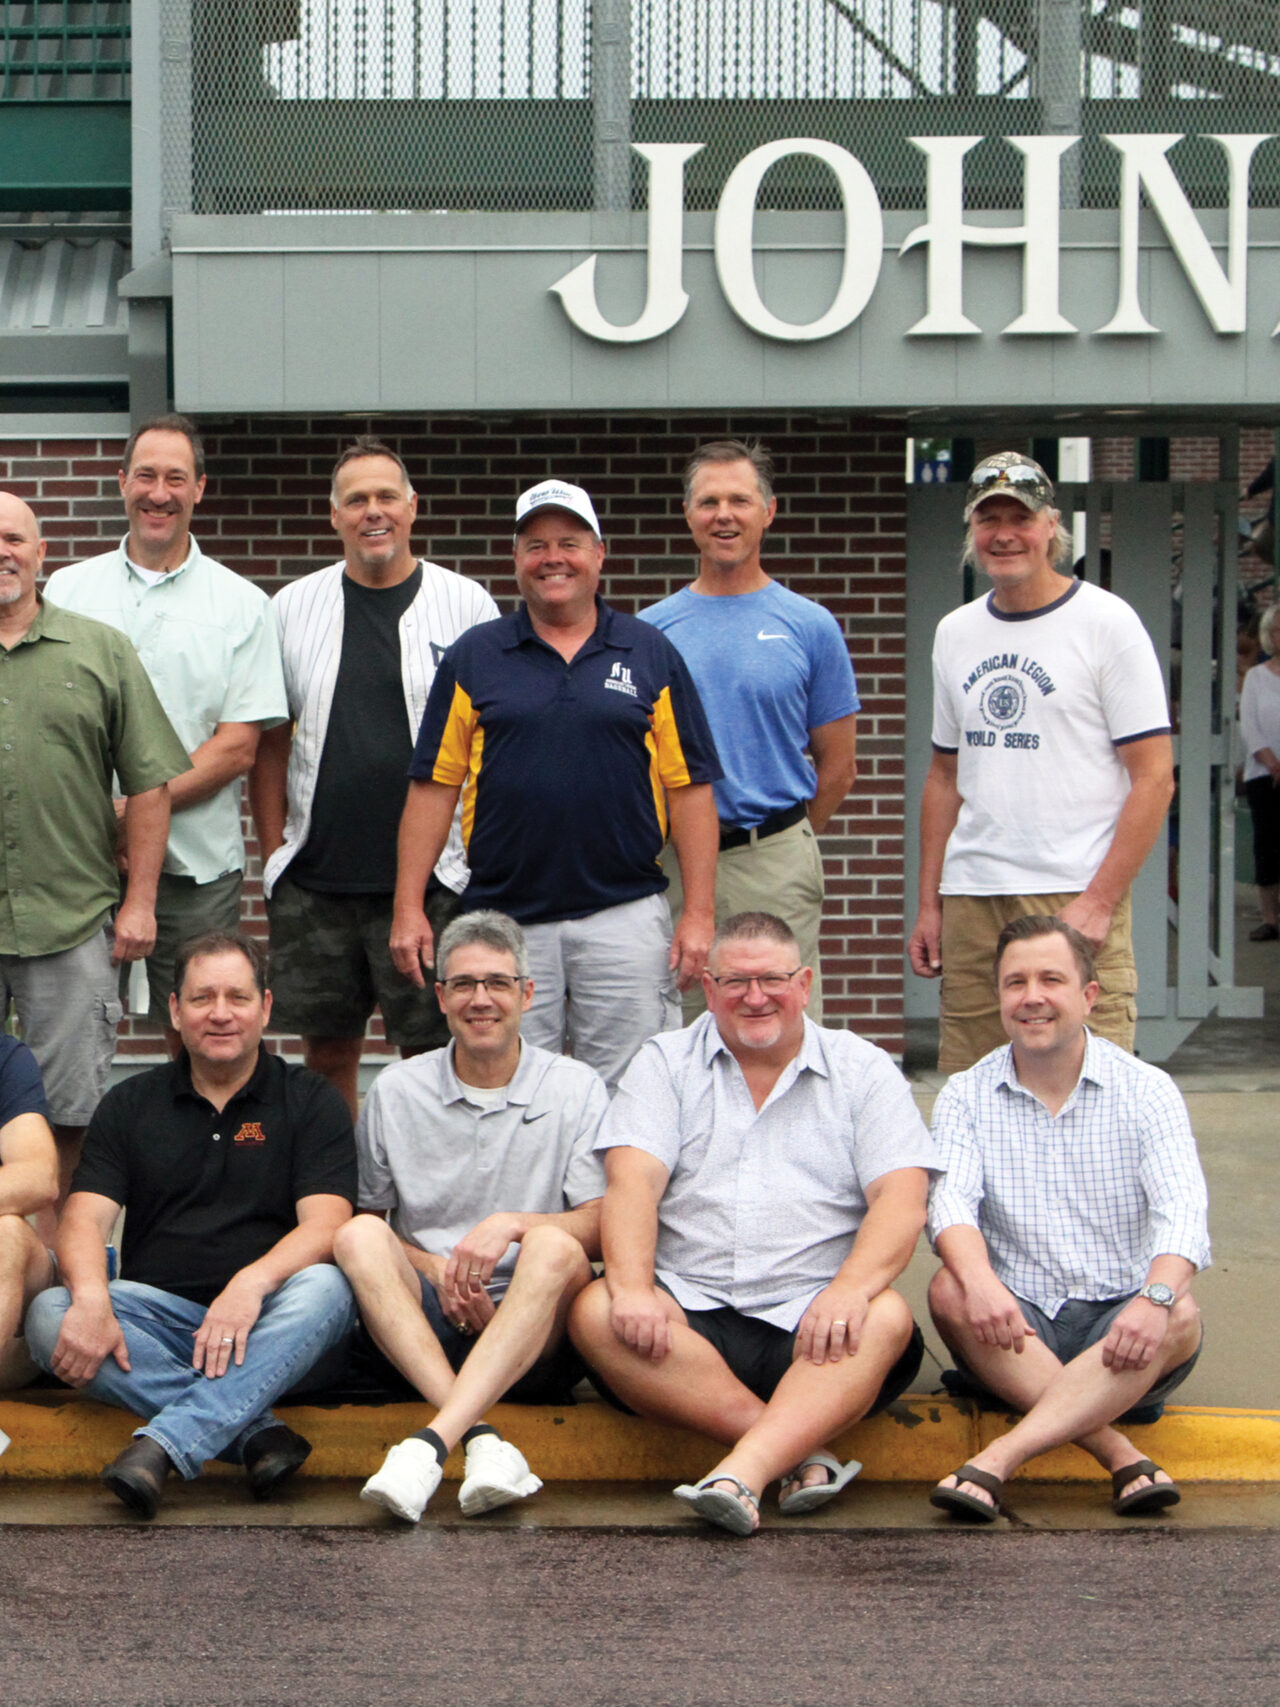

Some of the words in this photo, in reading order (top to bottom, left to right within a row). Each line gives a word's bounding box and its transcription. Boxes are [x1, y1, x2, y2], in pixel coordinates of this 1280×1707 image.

[547, 134, 1280, 343] JOHN
[962, 653, 1018, 695] AMERICAN
[1021, 656, 1056, 697] LEGION
[1004, 732, 1040, 750] SERIES
